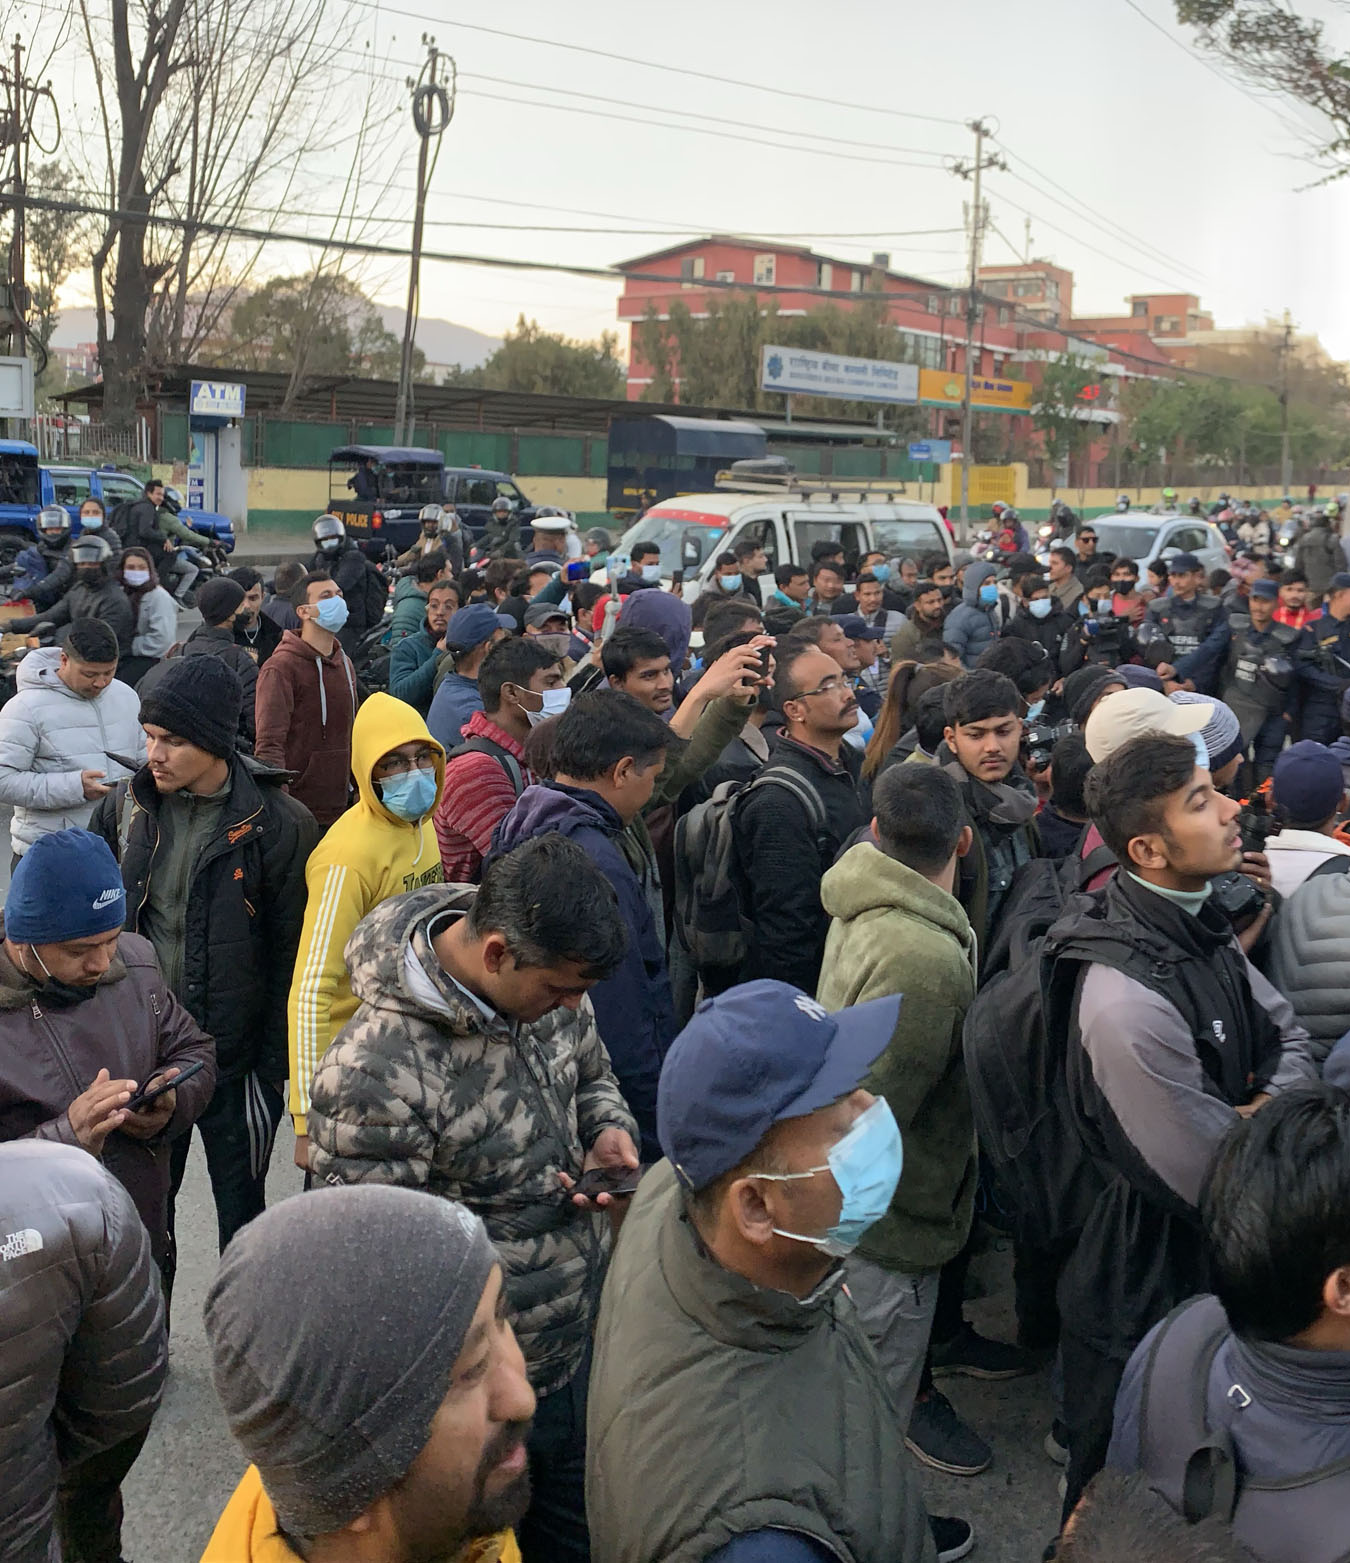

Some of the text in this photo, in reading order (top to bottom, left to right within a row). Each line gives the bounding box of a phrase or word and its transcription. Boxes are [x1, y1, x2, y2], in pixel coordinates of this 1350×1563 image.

[196, 383, 241, 401] ATM
[100, 888, 121, 900] NIKE
[5, 1231, 25, 1243] THE
[0, 1238, 25, 1253] ORTH
[3, 1247, 28, 1262] FACE
